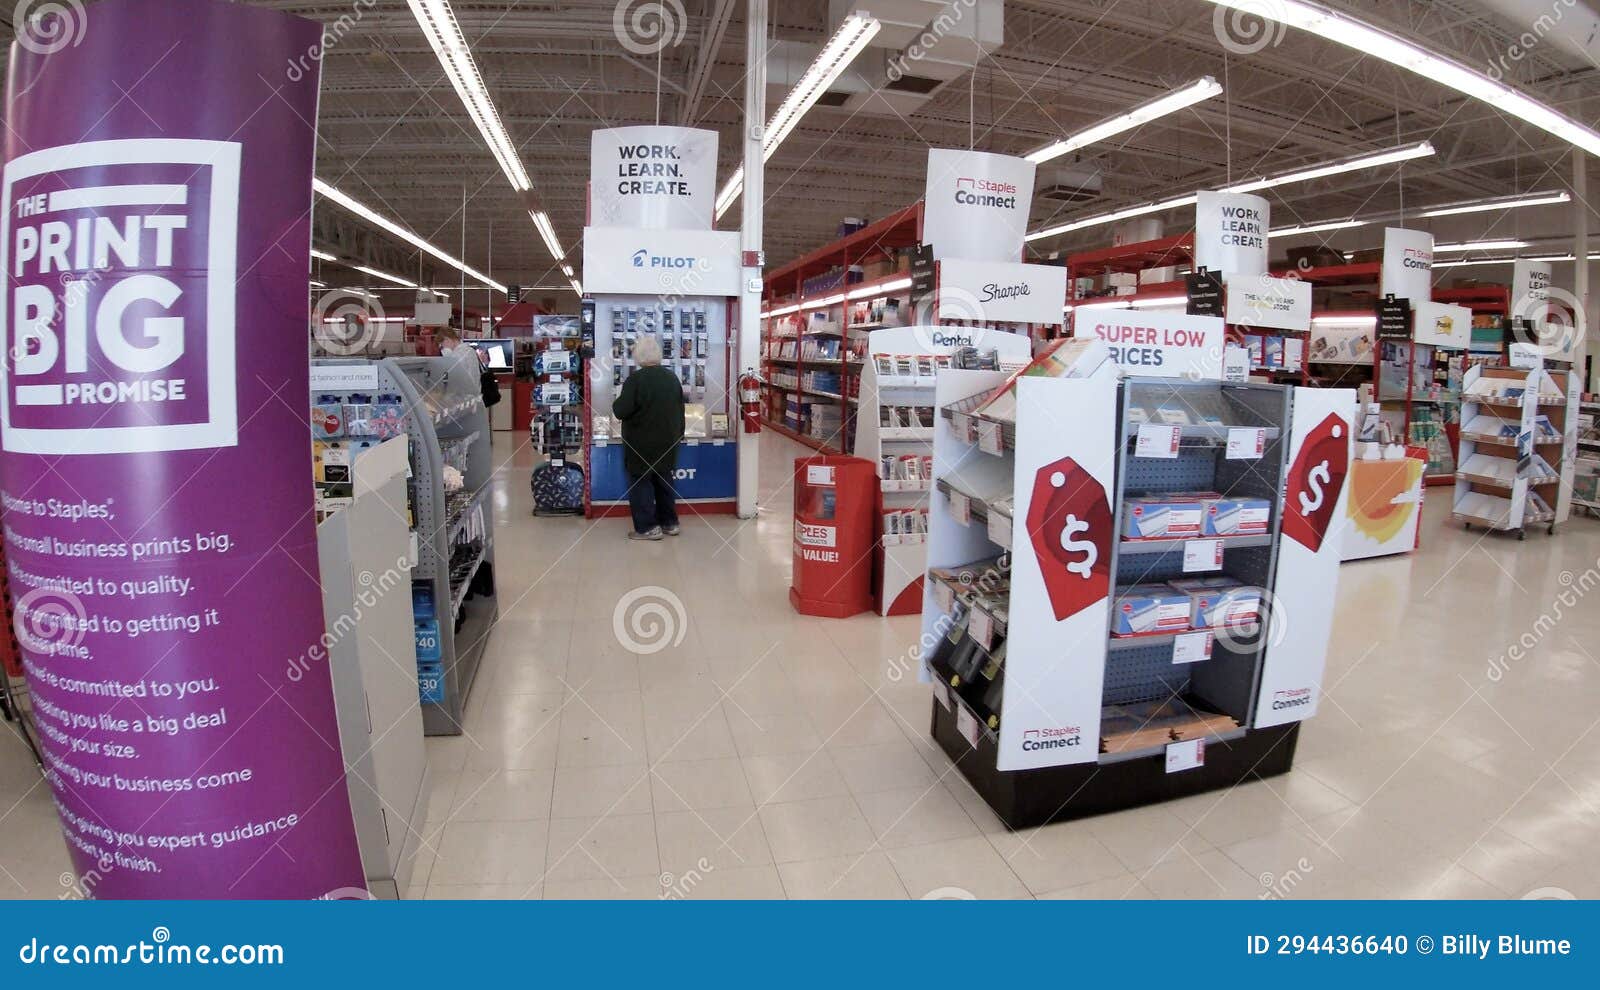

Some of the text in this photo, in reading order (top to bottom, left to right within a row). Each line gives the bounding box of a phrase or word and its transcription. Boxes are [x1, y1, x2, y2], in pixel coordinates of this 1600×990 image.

[618, 145, 681, 160] WORK.
[618, 163, 683, 178] LEARN.
[618, 181, 692, 196] CREATE.
[977, 179, 1016, 195] Staples
[17, 193, 48, 218] THE
[954, 190, 1016, 209] Connect
[15, 215, 187, 278] PRINT
[651, 256, 695, 268] PILOT
[979, 282, 1031, 303] Sharpie
[14, 275, 185, 375] BIG
[1095, 324, 1206, 348] SUPER LOW
[932, 331, 974, 347] Pentel
[65, 379, 186, 404] PROMISE
[53, 538, 128, 557] business
[133, 537, 192, 561] prints
[196, 531, 235, 553] big.
[803, 549, 839, 563] VALUE!
[97, 578, 117, 596] to
[121, 575, 196, 600] quality.
[102, 615, 122, 633] to
[126, 613, 201, 638] getting
[204, 608, 220, 627] it
[59, 677, 148, 698] committed
[151, 681, 172, 697] to
[176, 677, 220, 700] you.
[1271, 695, 1310, 710] Connect
[70, 713, 98, 728] you
[98, 713, 129, 732] like
[132, 719, 144, 733] a
[147, 713, 179, 736] big
[183, 707, 227, 730] deal
[1041, 725, 1081, 737] Staples
[69, 737, 101, 754] your
[102, 740, 141, 759] size.
[1022, 735, 1081, 752] Connect
[80, 769, 112, 786] your
[114, 773, 193, 792] business
[196, 768, 252, 789] come
[114, 831, 145, 847] you
[147, 832, 207, 852] expert
[210, 812, 299, 849] guidance
[114, 851, 162, 873] finish.
